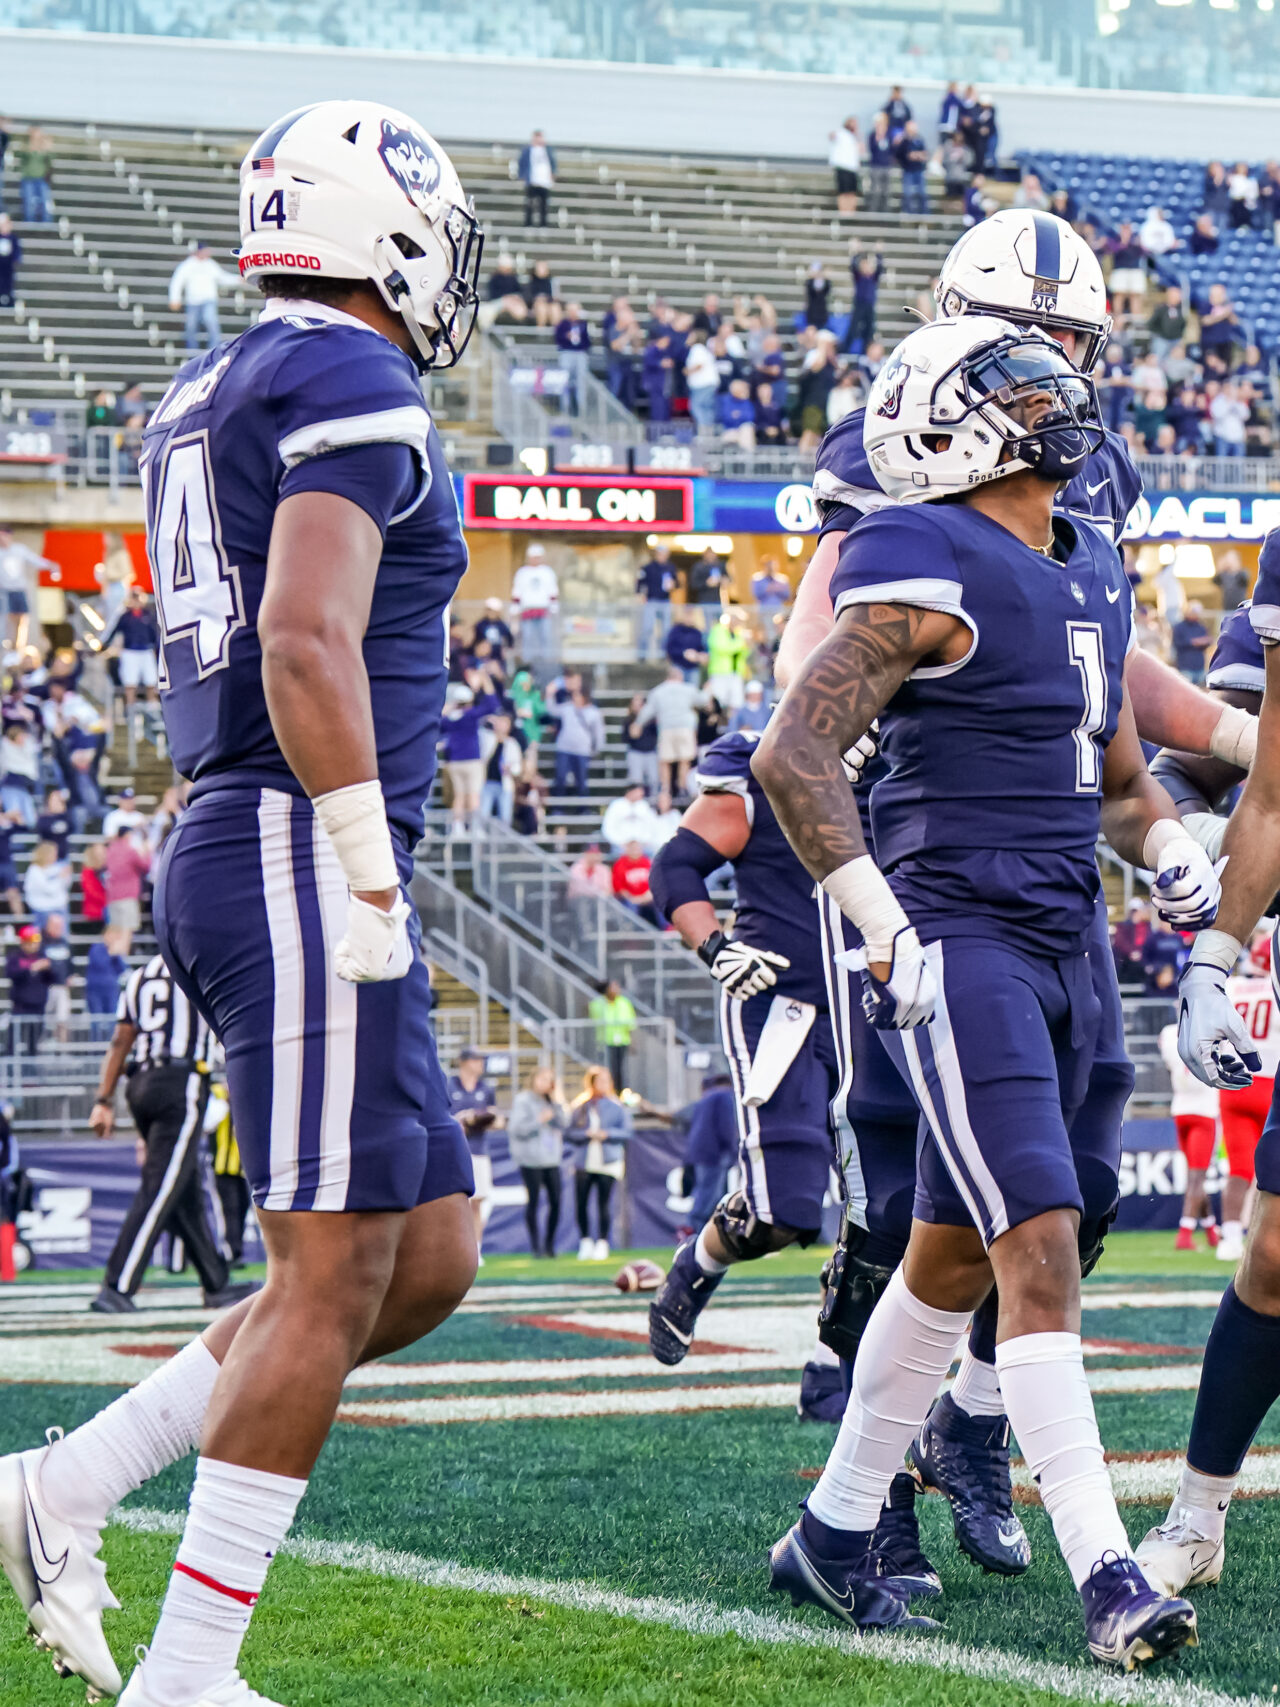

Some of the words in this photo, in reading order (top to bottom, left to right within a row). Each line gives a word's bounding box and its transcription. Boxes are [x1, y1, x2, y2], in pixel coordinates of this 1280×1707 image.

[249, 189, 286, 232] 14
[494, 486, 592, 521] BALL
[597, 488, 656, 522] ON
[1066, 620, 1106, 794] 1
[139, 979, 169, 1032] C
